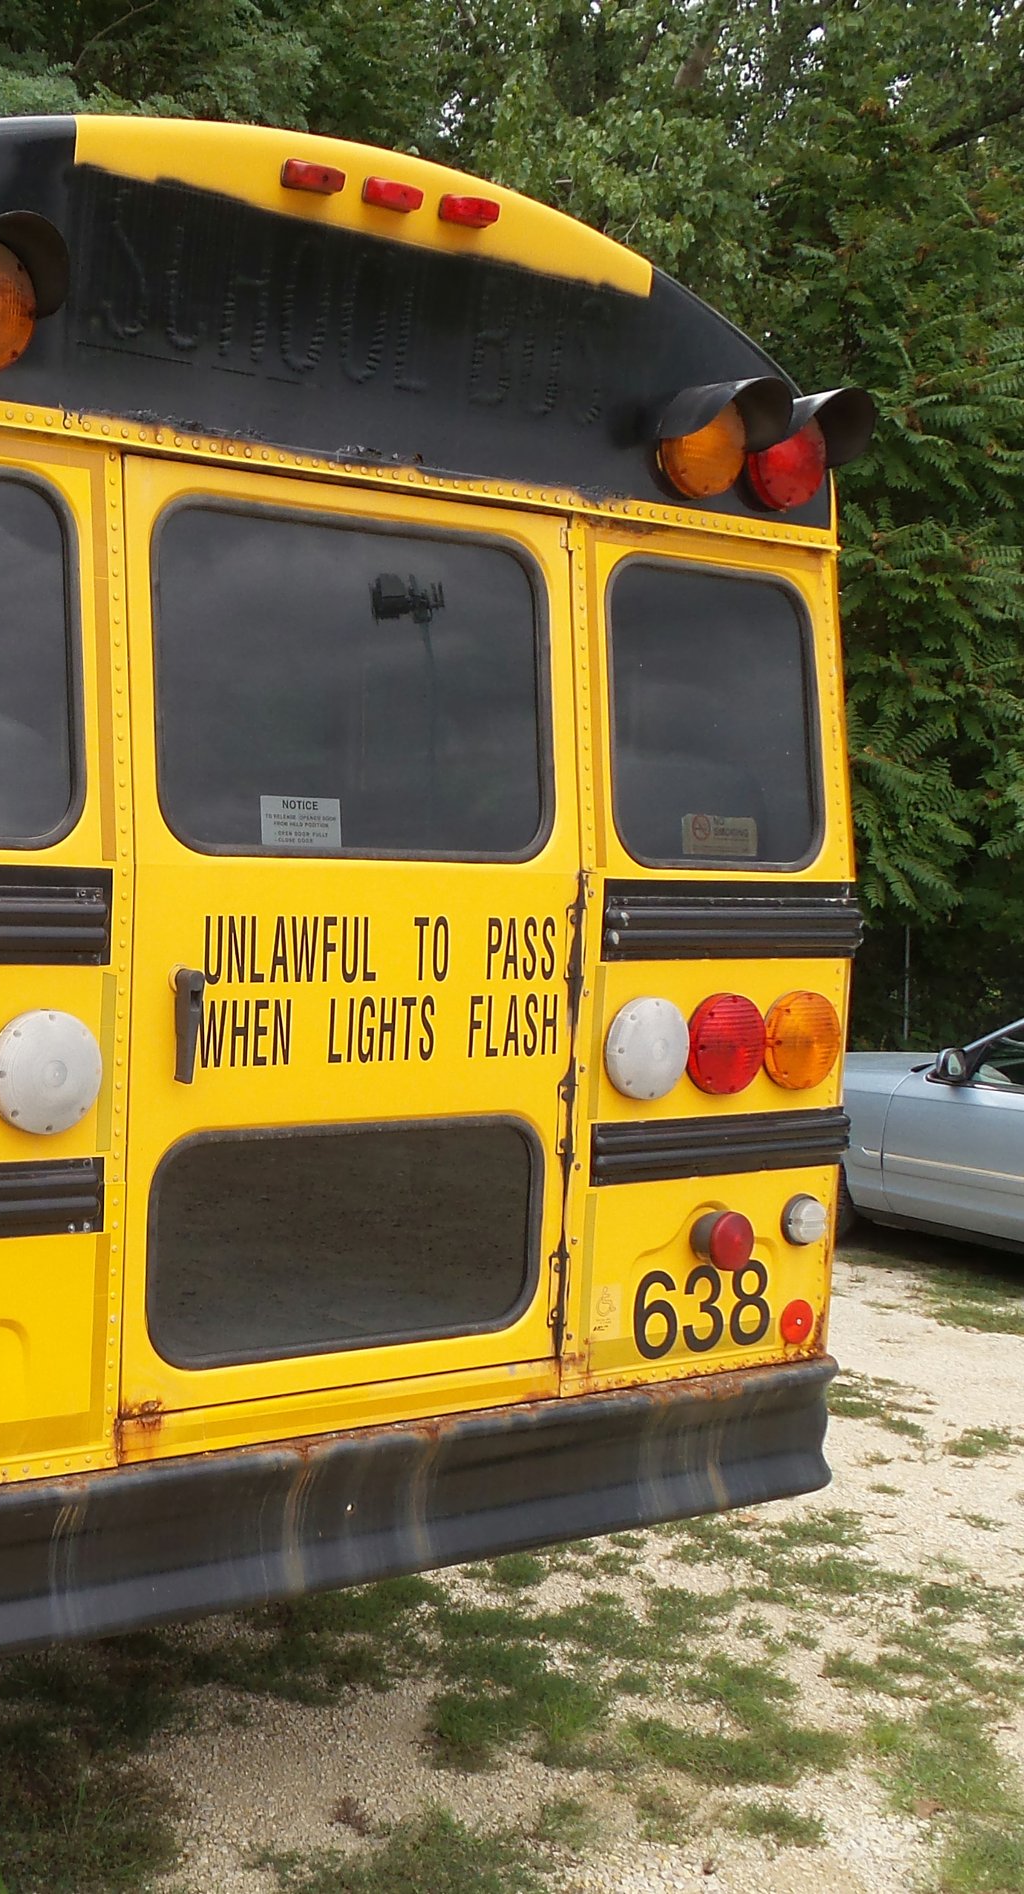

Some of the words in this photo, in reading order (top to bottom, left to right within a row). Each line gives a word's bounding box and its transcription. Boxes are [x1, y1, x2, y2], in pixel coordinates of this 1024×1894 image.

[282, 799, 319, 811] NOTICE
[203, 914, 376, 985] UNLAWFUL
[414, 916, 450, 982] TO
[486, 916, 556, 981] PASS
[199, 998, 292, 1068] WHEN
[327, 994, 435, 1064] LIGHTS
[467, 993, 558, 1059] FLASH
[632, 1258, 772, 1360] 638
